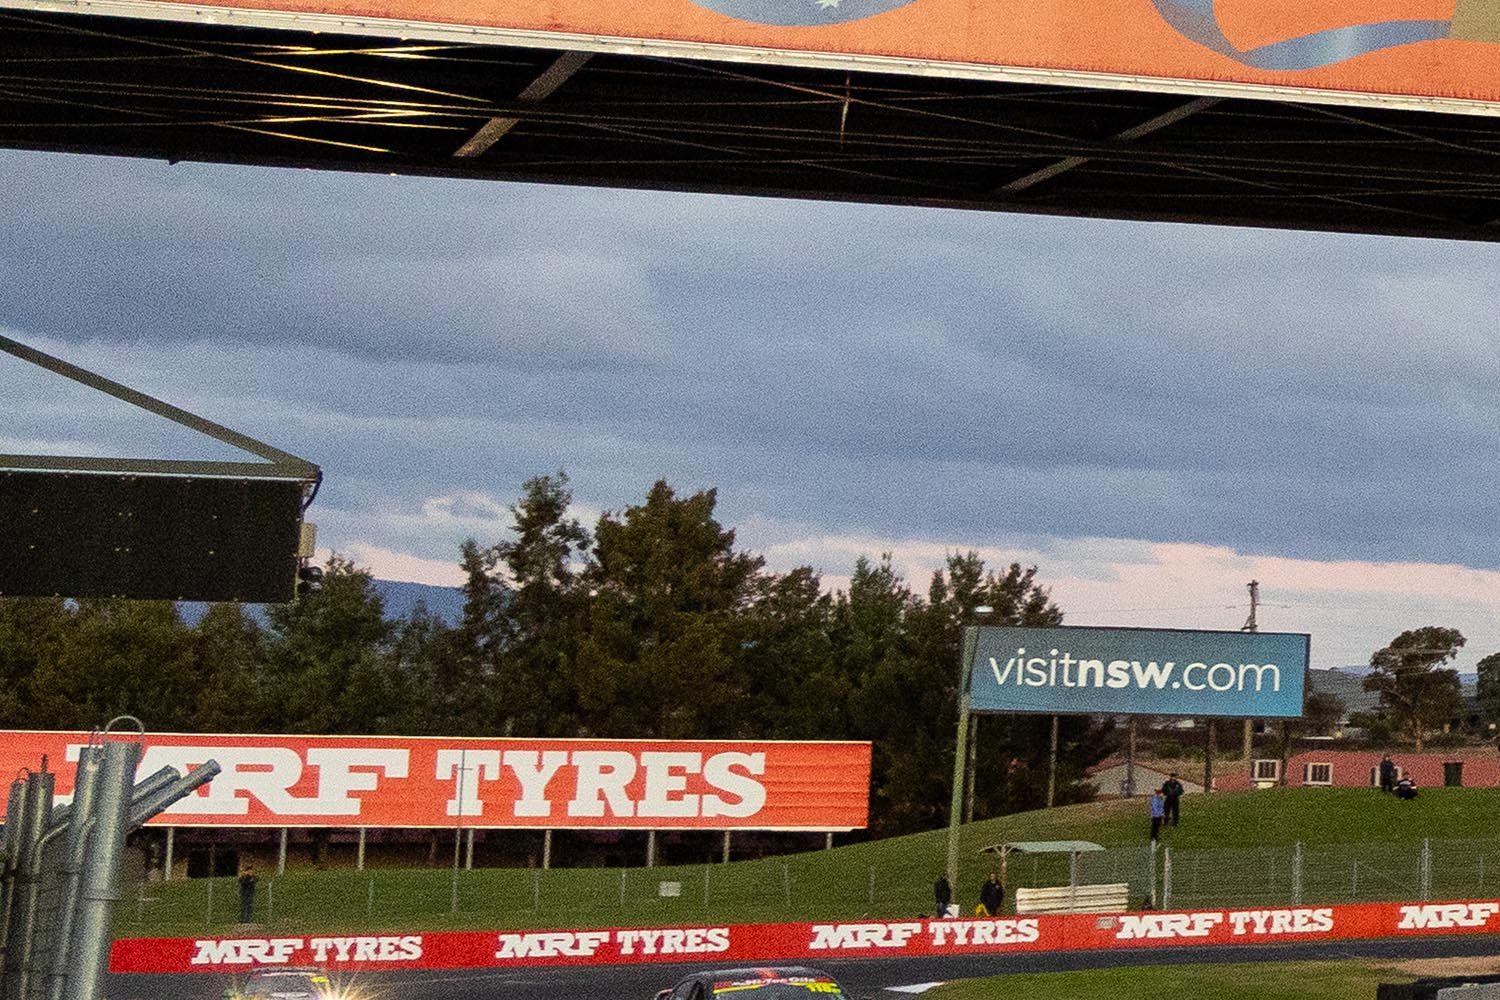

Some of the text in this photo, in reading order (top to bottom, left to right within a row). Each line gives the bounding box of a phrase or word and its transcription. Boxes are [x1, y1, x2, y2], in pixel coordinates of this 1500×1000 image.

[988, 647, 1282, 693] visitnsw.com
[435, 749, 768, 819] TYRES
[1115, 908, 1335, 939] MRF TYRES
[1397, 902, 1500, 930] MRF
[495, 927, 731, 960] MRF TYRES
[809, 917, 1041, 950] MRF TYRES
[191, 935, 424, 966] MRF TYRES
